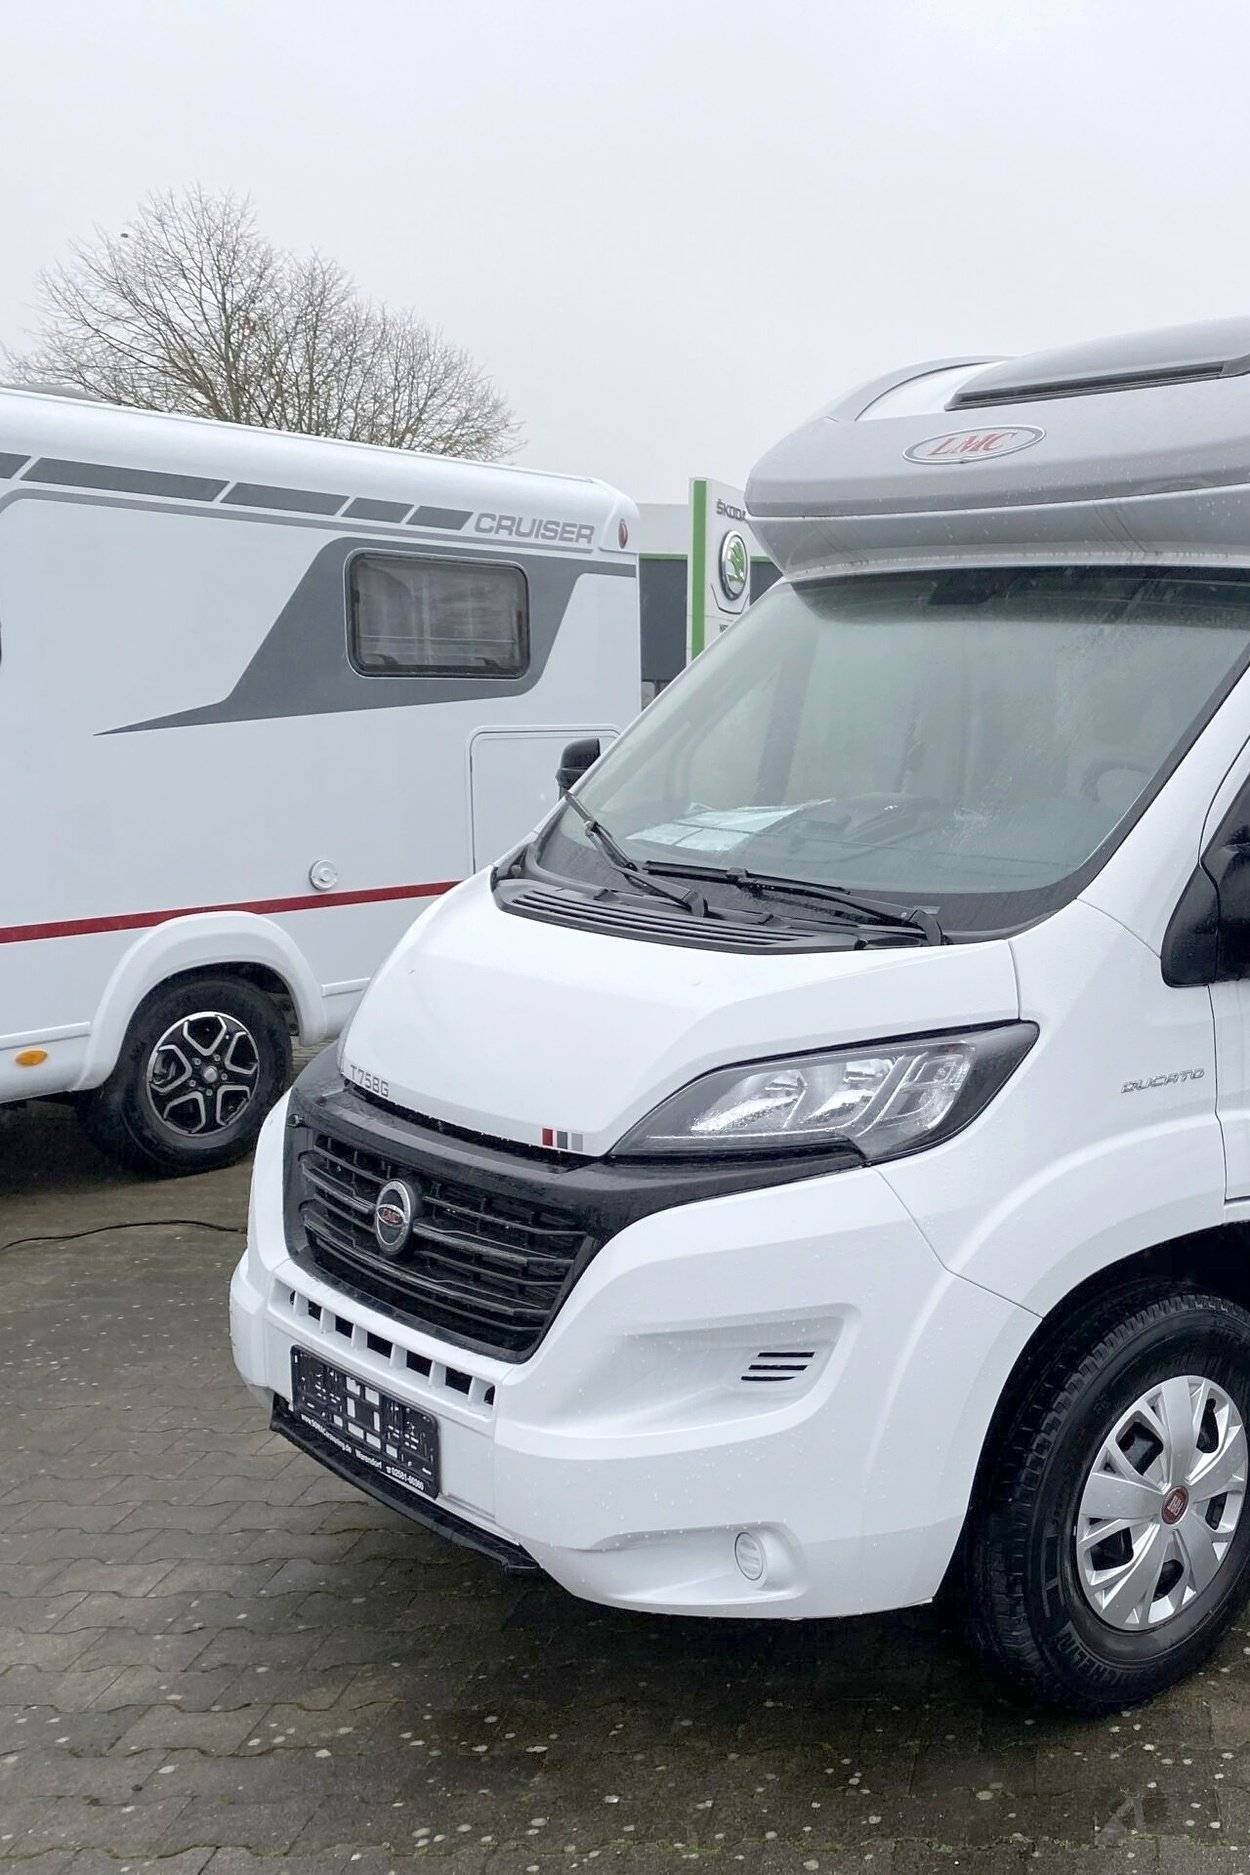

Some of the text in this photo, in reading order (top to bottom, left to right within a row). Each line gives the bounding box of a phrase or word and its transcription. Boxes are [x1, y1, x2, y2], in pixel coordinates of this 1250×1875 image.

[926, 431, 1018, 456] LMC
[474, 512, 595, 544] CRUISER
[1121, 1067, 1205, 1094] DUCATO
